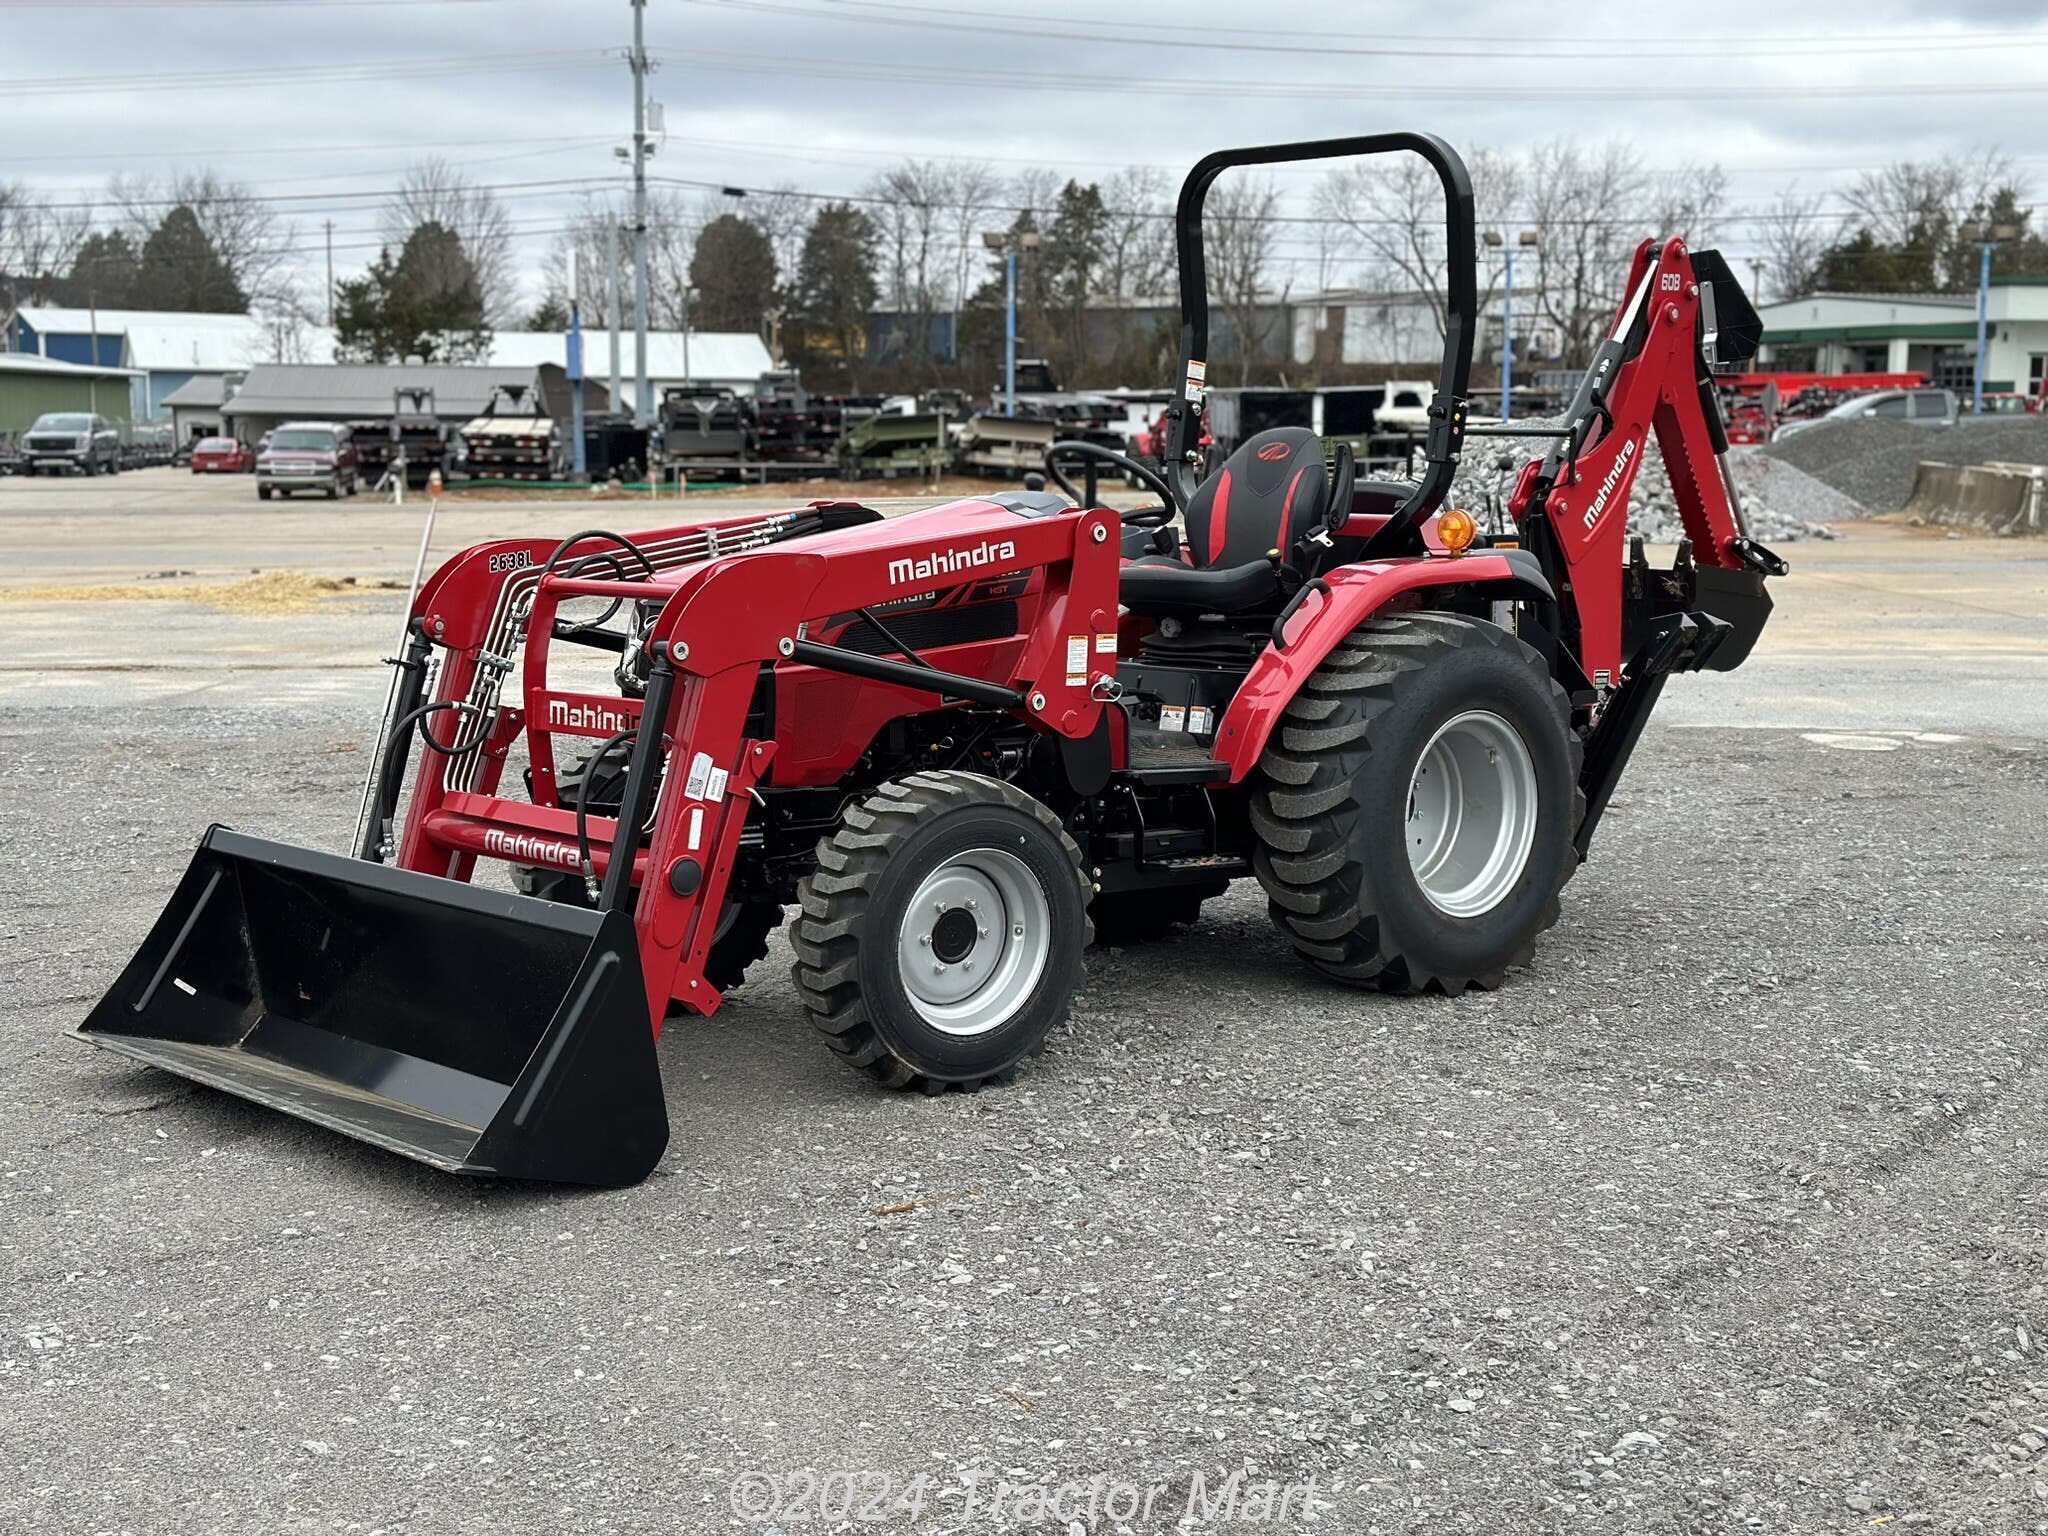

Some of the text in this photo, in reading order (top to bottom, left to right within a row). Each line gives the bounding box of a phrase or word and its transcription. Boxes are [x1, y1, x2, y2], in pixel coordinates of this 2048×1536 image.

[1583, 439, 1635, 529] Mahindra
[489, 550, 533, 573] 2638L
[889, 541, 1015, 585] Mahindra
[484, 828, 581, 867] Mahindra
